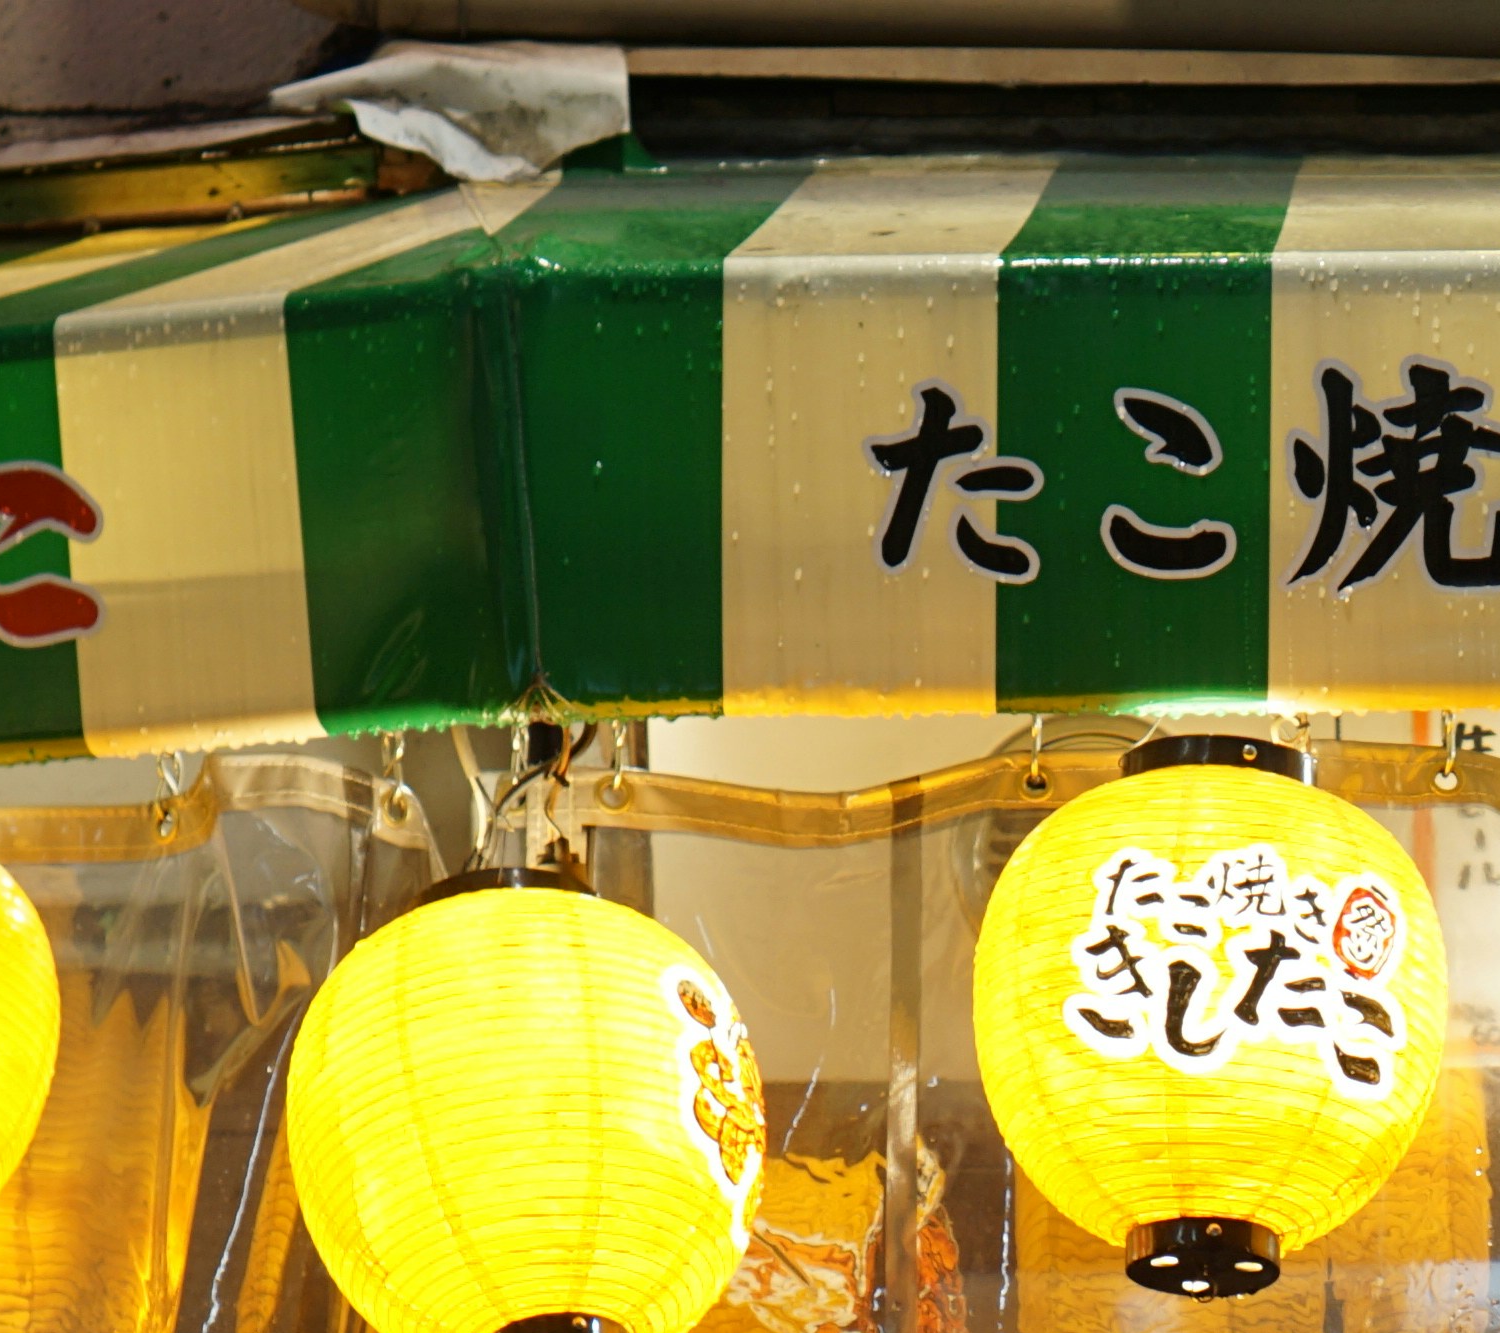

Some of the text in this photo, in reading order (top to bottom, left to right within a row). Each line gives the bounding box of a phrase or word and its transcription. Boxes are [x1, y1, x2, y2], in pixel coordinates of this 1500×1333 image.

[1106, 854, 1327, 945] たこ焼き
[1078, 924, 1395, 1085] きしたこ
